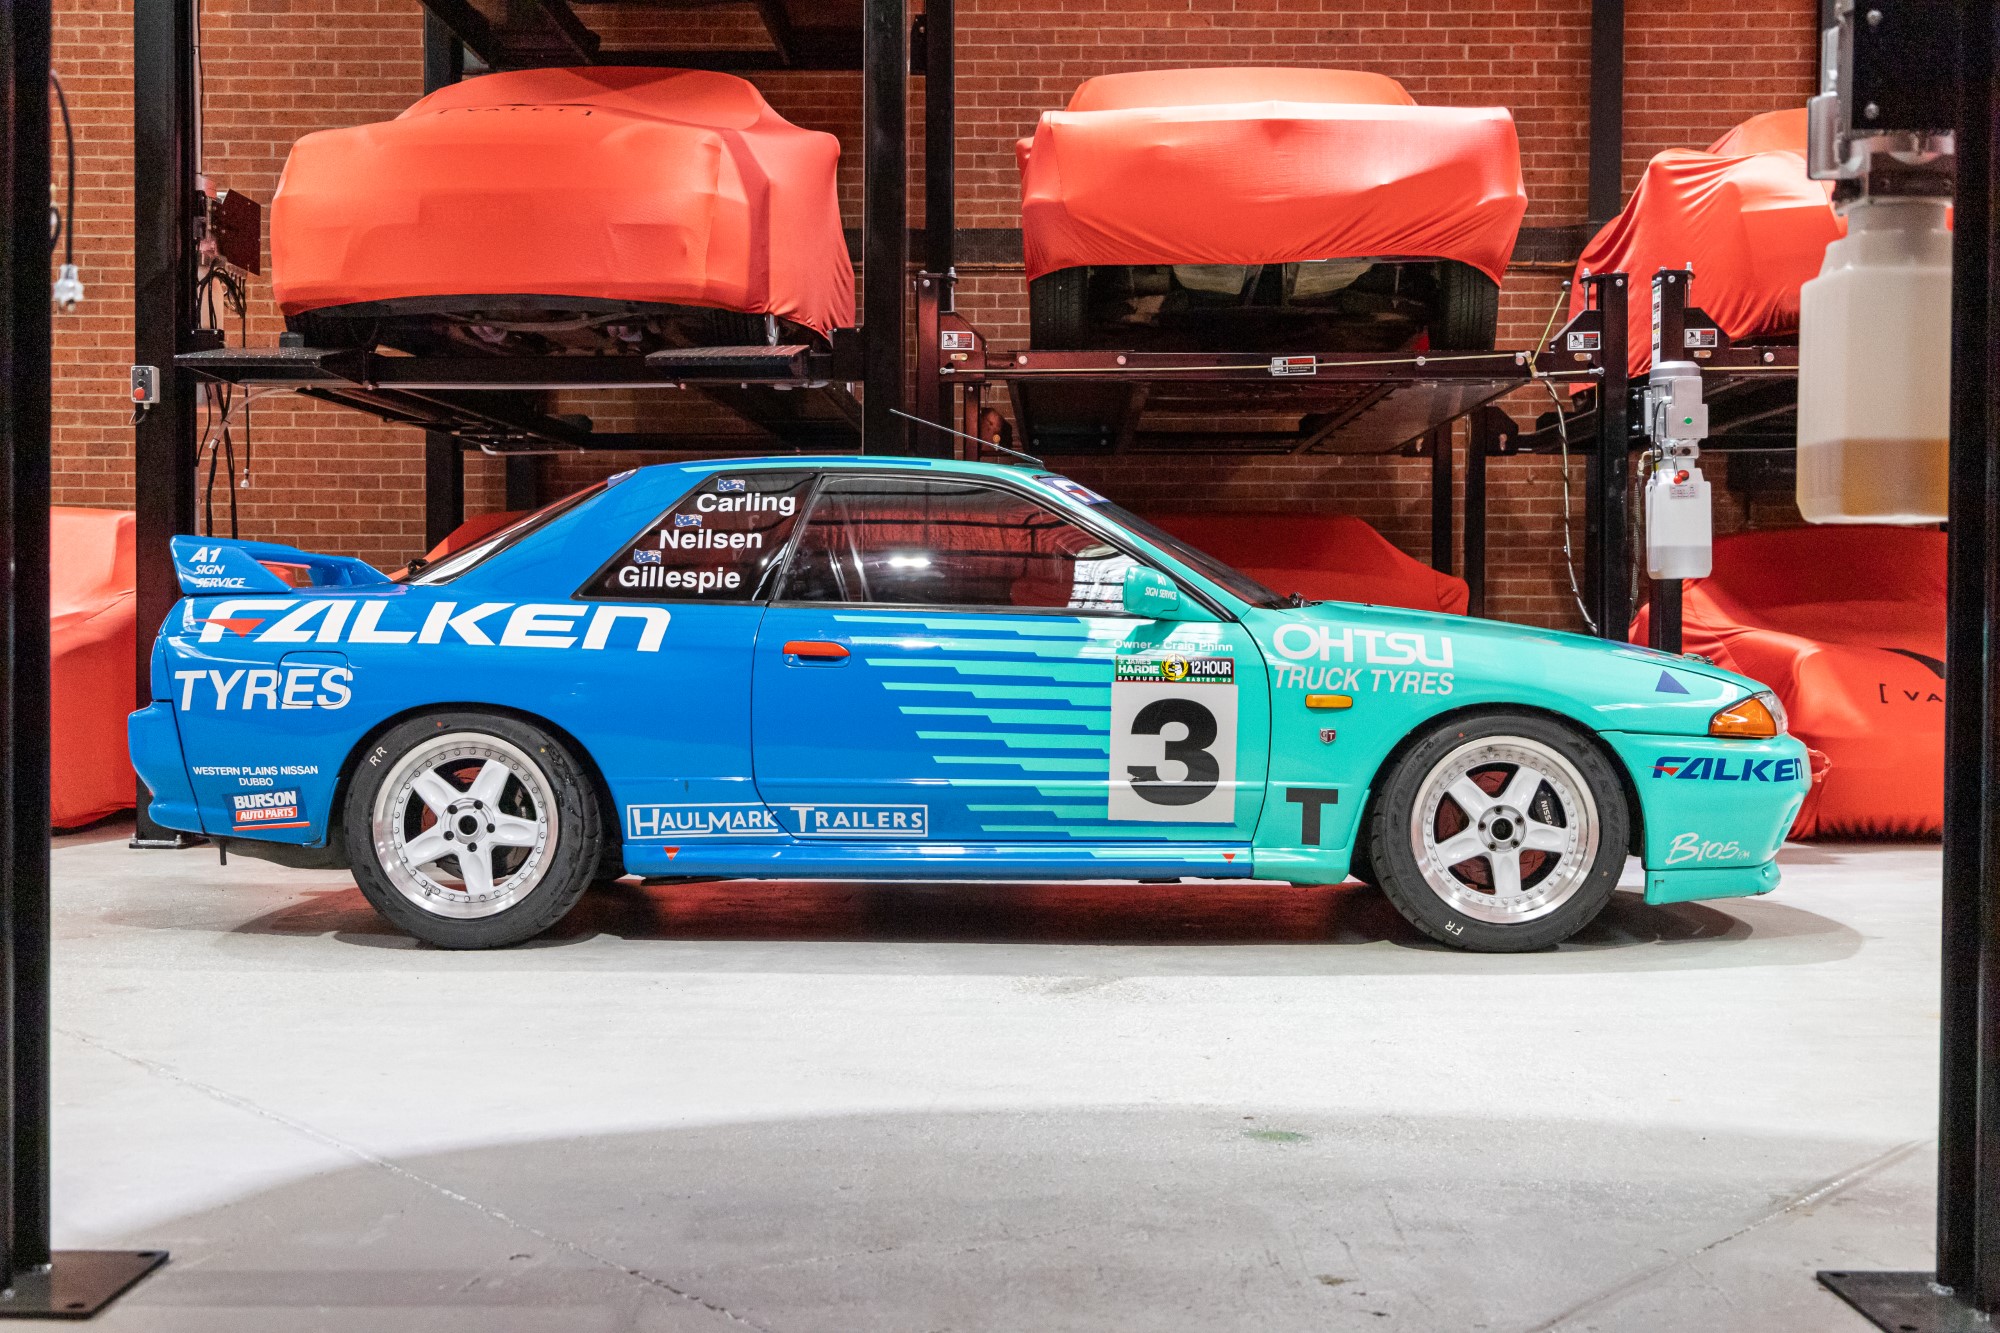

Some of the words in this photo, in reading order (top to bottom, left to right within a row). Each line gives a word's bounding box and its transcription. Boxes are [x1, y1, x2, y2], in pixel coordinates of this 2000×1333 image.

[696, 493, 796, 517] Carling
[659, 529, 762, 549] Neilsen
[188, 546, 222, 563] A1
[194, 564, 226, 575] SIGN
[195, 577, 246, 588] SERVICE
[618, 566, 741, 594] Gillespie
[1145, 587, 1158, 598] SIGN
[1159, 588, 1177, 600] SERVICE
[196, 599, 672, 653] FALKEN
[1113, 640, 1153, 649] Owner
[1163, 641, 1195, 652] Craig
[1200, 642, 1233, 652] Phinn
[1272, 623, 1454, 668] OHTSU
[1118, 664, 1159, 674] HARDIE
[1190, 661, 1201, 674] 12
[1202, 661, 1231, 675] HOUR
[174, 667, 354, 711] TYRES
[1275, 665, 1363, 692] TRUCK
[1370, 670, 1455, 695] TYRES
[369, 746, 388, 767] RR
[1127, 698, 1220, 806] 3
[193, 766, 240, 775] WESTERN
[242, 766, 278, 775] PLAINS
[280, 765, 318, 775] NISSAN
[1651, 756, 1803, 782] FALKEN
[239, 777, 273, 786] DUBBO
[233, 791, 296, 809] BURSON
[240, 810, 263, 821] AUTO
[265, 807, 294, 819] PARTS
[632, 808, 779, 836] HAULMARK
[789, 806, 923, 833] TRAILERS
[1286, 787, 1338, 846] T
[1540, 800, 1553, 826] NISSA
[1665, 832, 1739, 865] B105
[1444, 920, 1464, 936] FR
